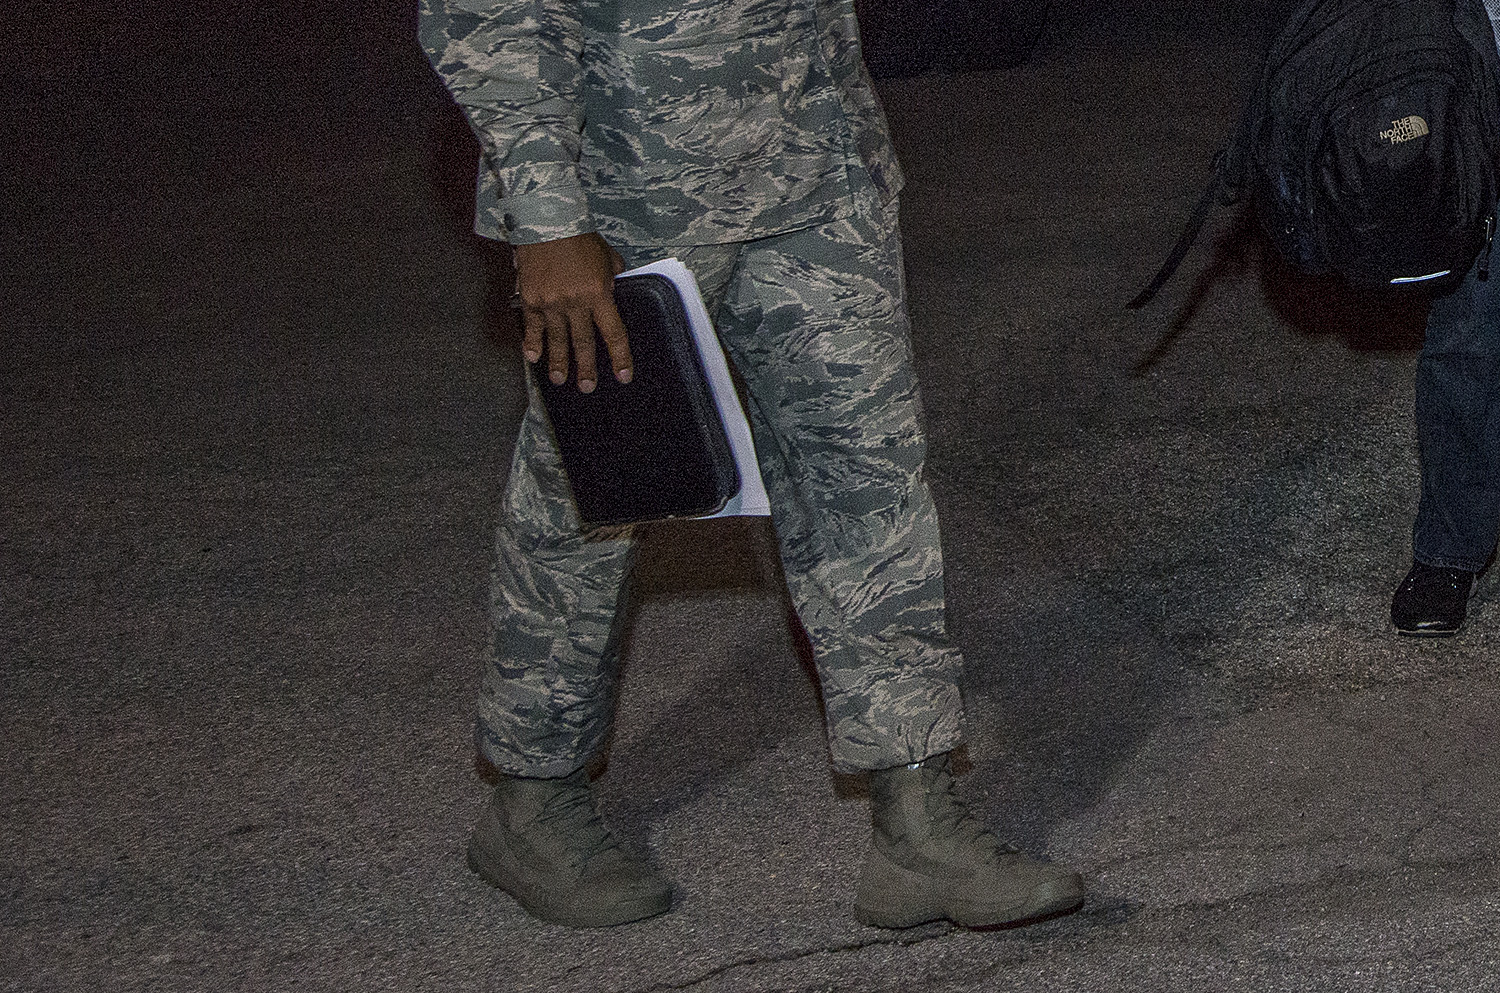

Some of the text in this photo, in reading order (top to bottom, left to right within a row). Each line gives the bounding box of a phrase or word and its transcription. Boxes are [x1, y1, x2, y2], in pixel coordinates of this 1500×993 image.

[1391, 117, 1411, 129] THE
[1379, 124, 1414, 140] NORTH
[1390, 133, 1415, 145] FACE
